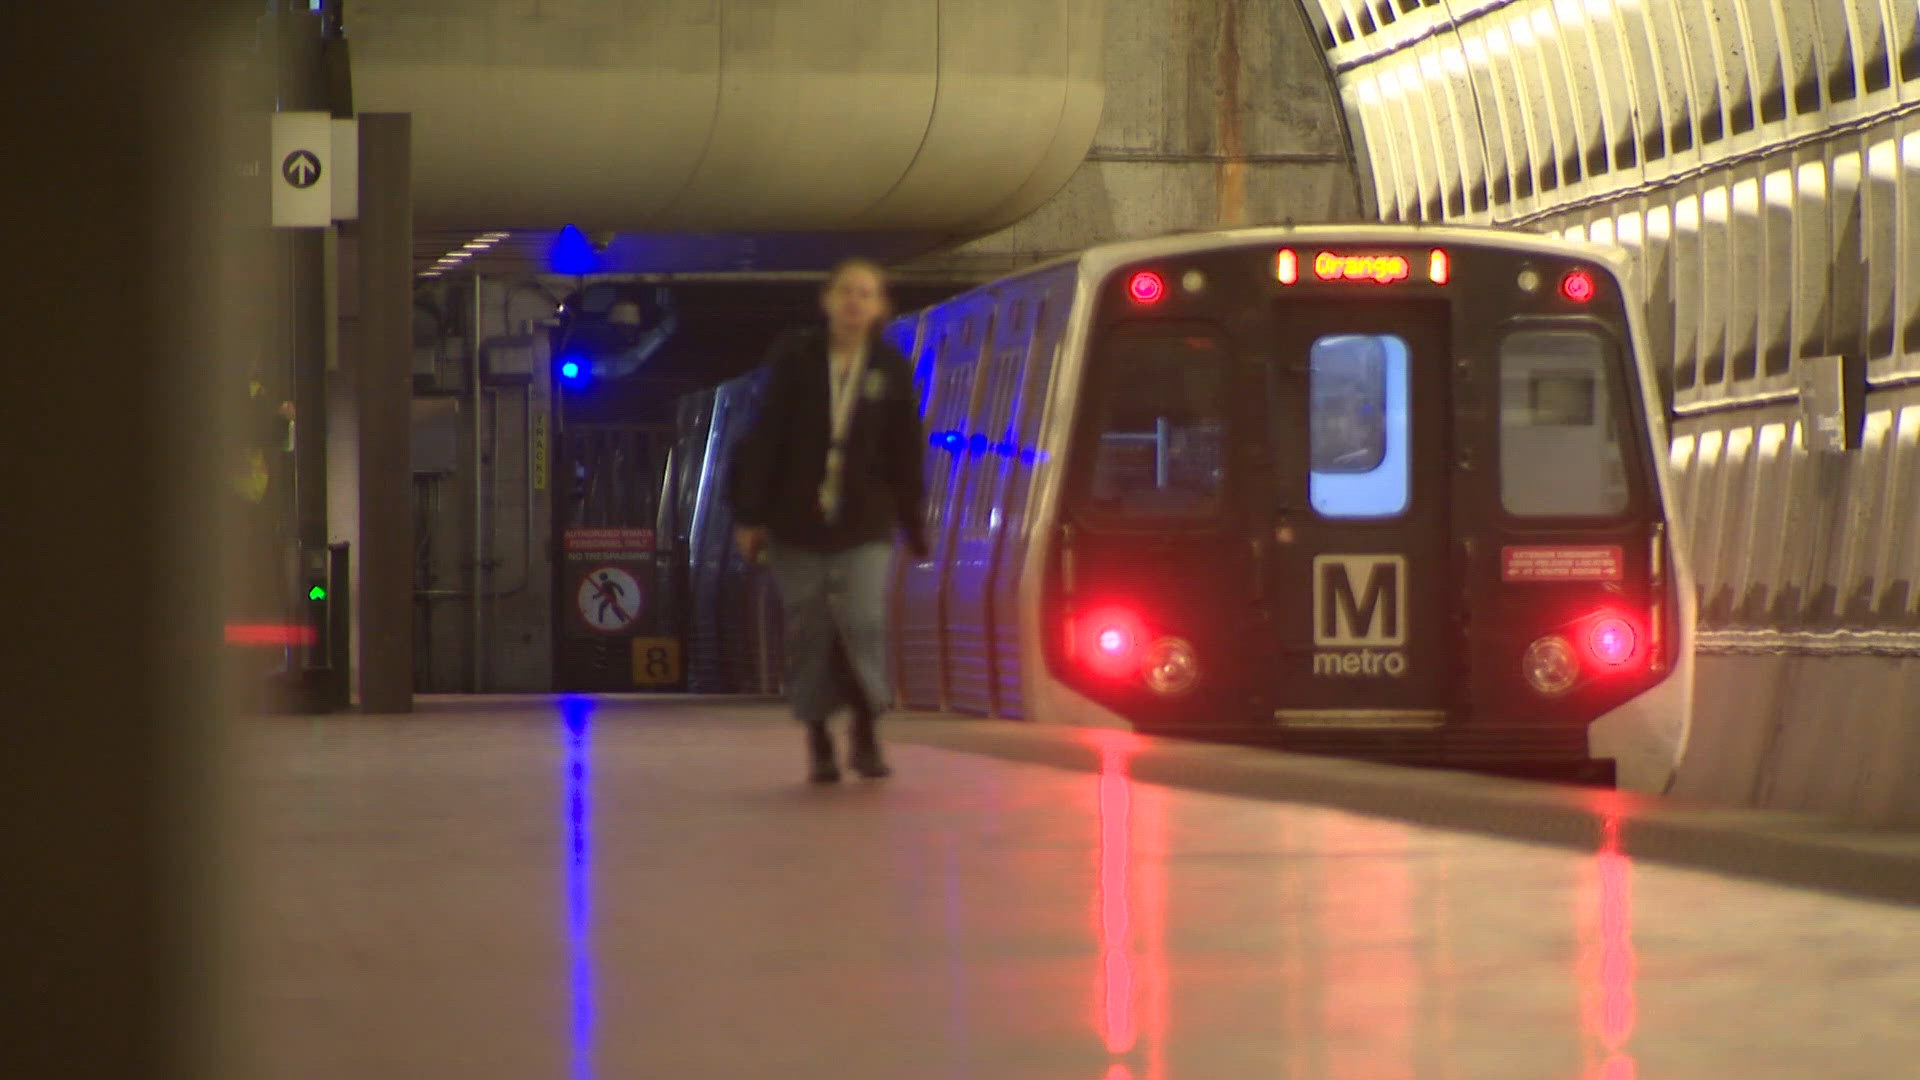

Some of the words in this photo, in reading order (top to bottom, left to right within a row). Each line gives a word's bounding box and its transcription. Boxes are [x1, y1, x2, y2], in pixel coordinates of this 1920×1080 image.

[1316, 252, 1408, 283] Orange
[535, 414, 544, 472] TRACK
[568, 552, 582, 560] NO
[585, 552, 649, 560] TRESPASSING
[1321, 562, 1397, 639] M
[646, 647, 669, 677] 8
[1313, 649, 1404, 674] metro
